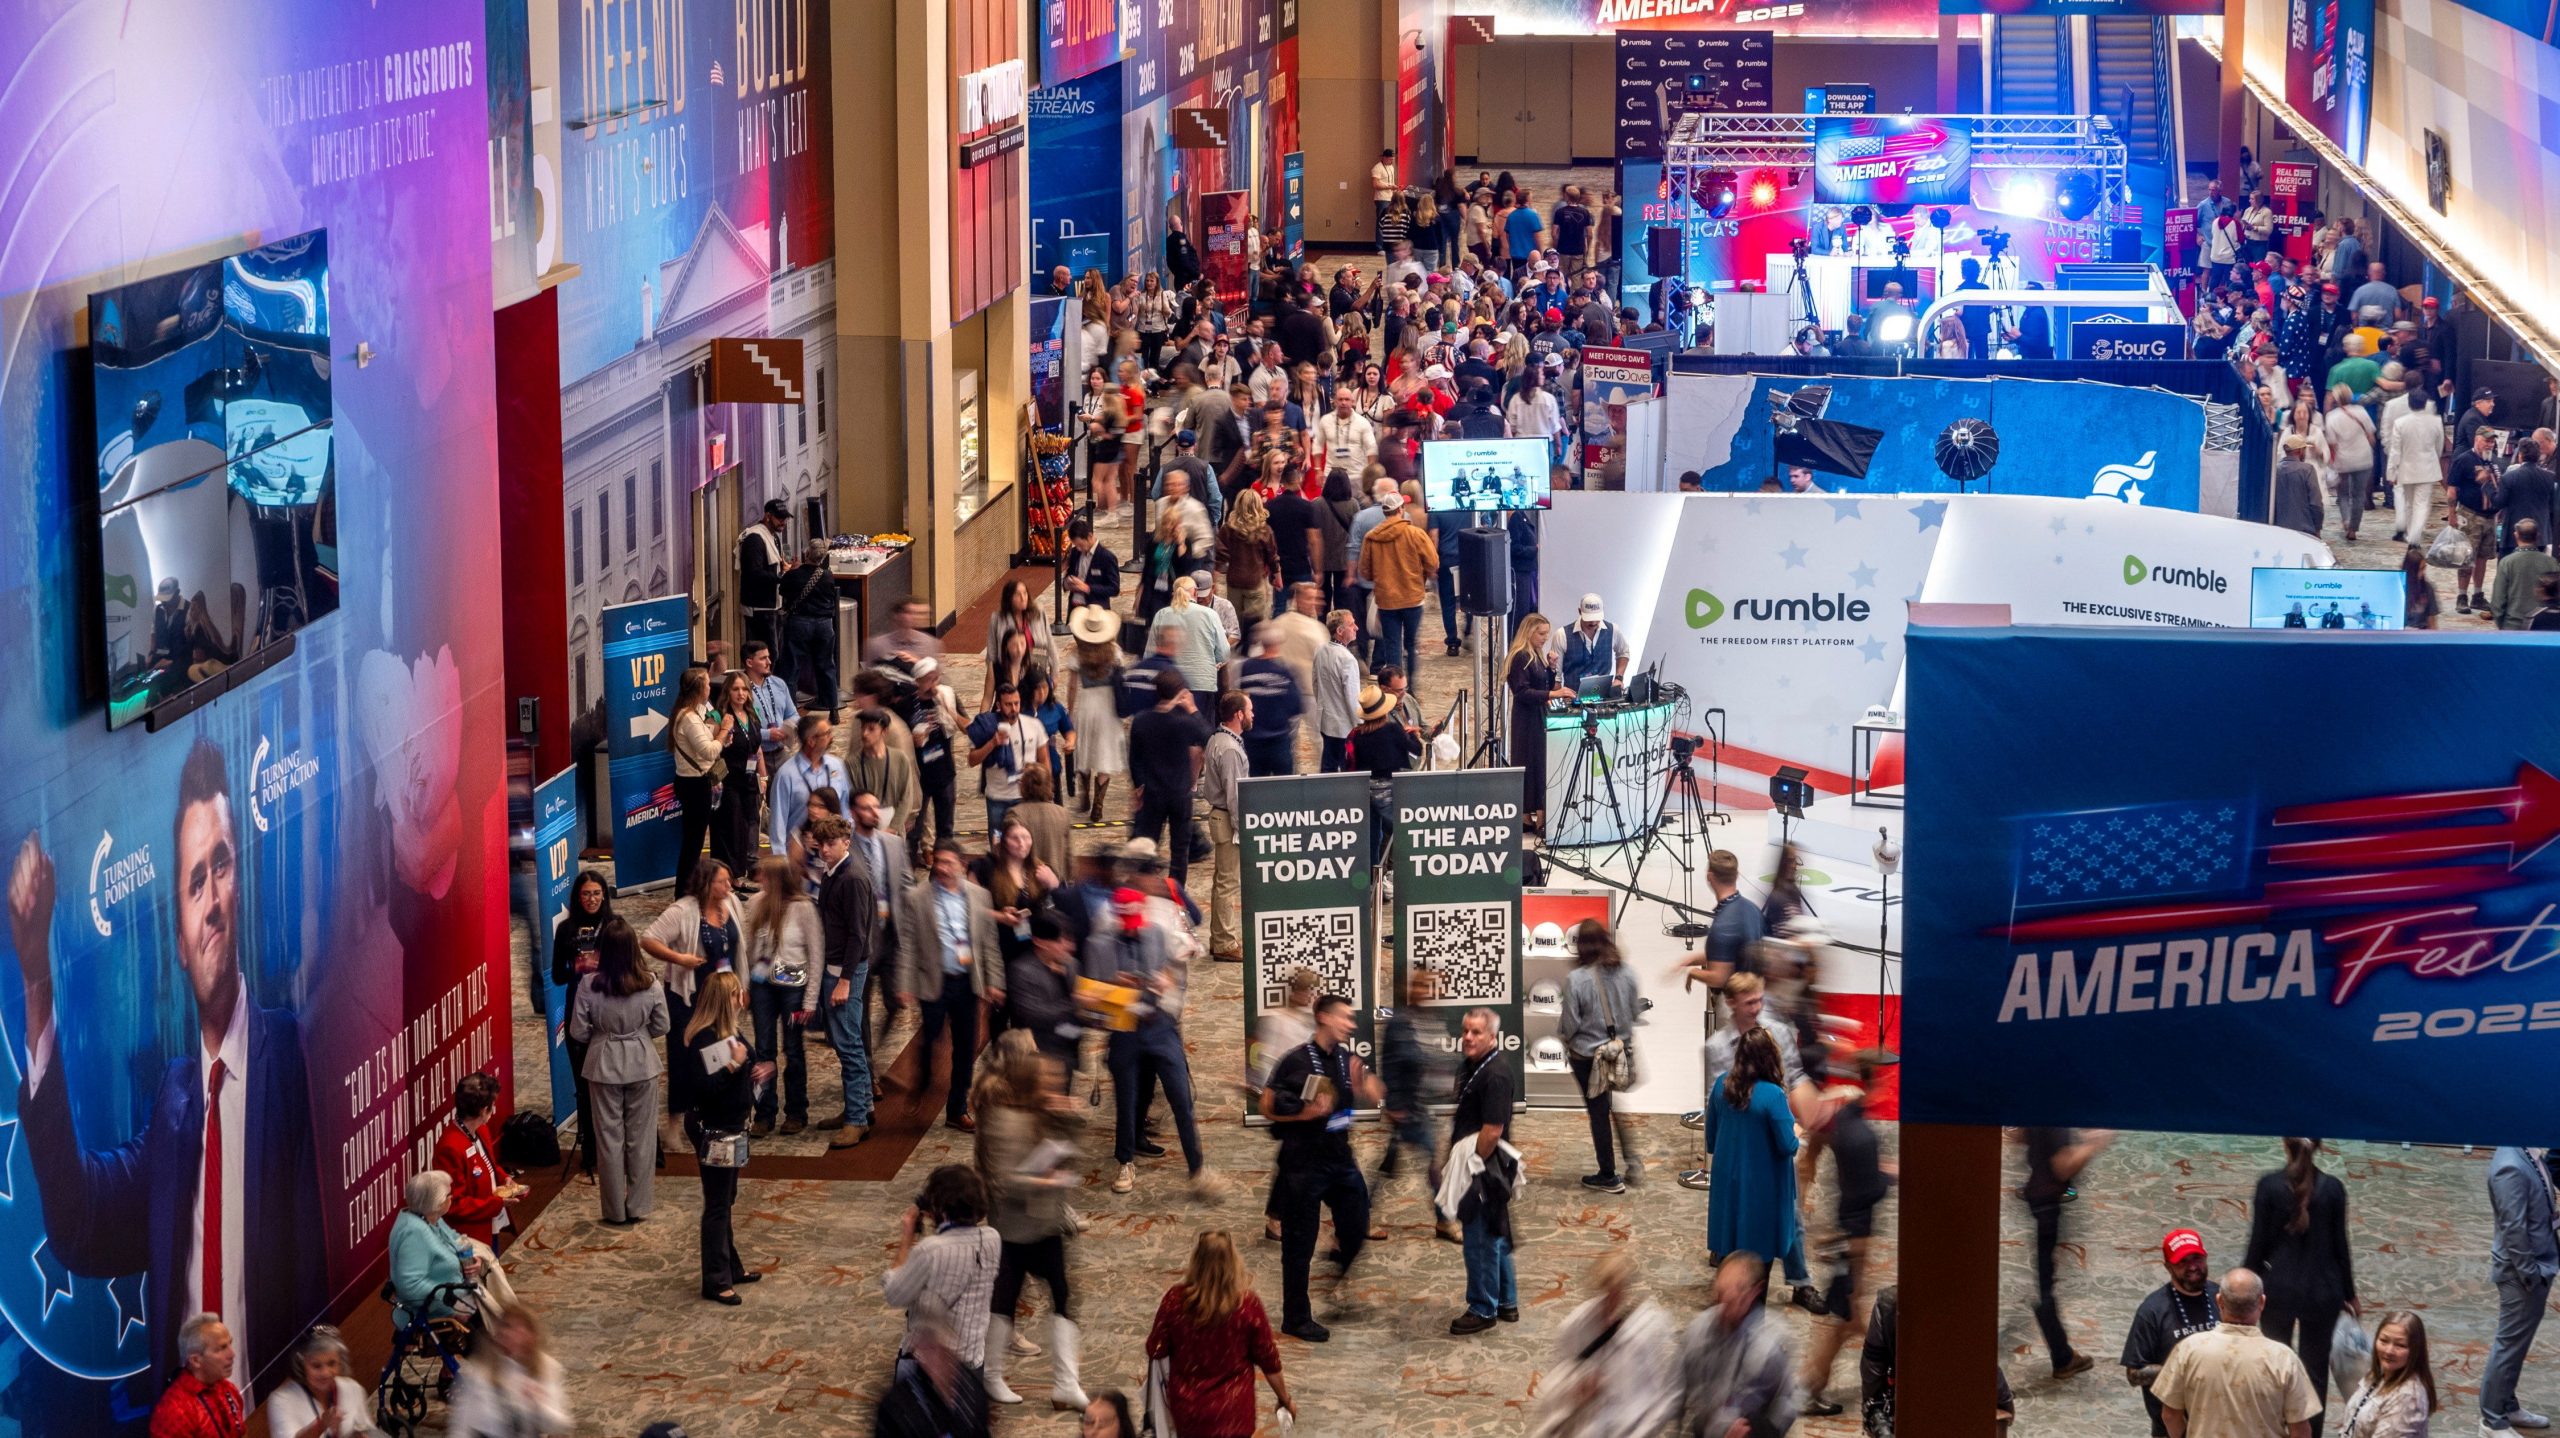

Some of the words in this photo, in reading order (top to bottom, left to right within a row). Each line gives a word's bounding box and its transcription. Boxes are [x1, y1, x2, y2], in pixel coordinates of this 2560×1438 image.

[1735, 4, 1804, 24] 2025
[736, 0, 808, 100] BUILD
[1629, 38, 1651, 46] rumble
[1706, 39, 1729, 47] rumble
[1179, 43, 1195, 77] 2016
[299, 62, 352, 122] MOVEMENT
[357, 59, 369, 110] IS
[374, 57, 380, 106] A
[384, 40, 473, 104] GRASSROOTS
[1139, 59, 1156, 96] 2003
[1744, 99, 1767, 107] rumble
[738, 99, 777, 175] WHAT'S
[783, 89, 808, 159] NEXT
[311, 126, 365, 187] MOVEMENT
[370, 121, 381, 173] AT
[384, 117, 402, 169] ITS
[972, 149, 984, 162] QUICK
[985, 143, 997, 157] BITES
[1000, 137, 1010, 151] COLD
[584, 137, 640, 233] WHAT'S
[650, 123, 687, 209] OURS
[1835, 161, 1897, 183] AMERICA
[1906, 174, 1946, 184] 2025
[2274, 176, 2312, 185] AMERICA'S
[2276, 168, 2293, 176] REAL
[2274, 184, 2297, 193] VOICE
[1535, 340, 1554, 348] JESUS
[1588, 352, 1604, 360] MEET
[1606, 354, 1627, 362] FOURG
[1628, 356, 1645, 364] DAVE
[2152, 566, 2228, 594] rumble
[1733, 592, 1871, 622] rumble
[2062, 601, 2087, 613] THE
[2089, 603, 2153, 621] EXCLUSIVE
[1700, 637, 1719, 645] THE
[1722, 637, 1768, 645] FREEDOM
[1771, 638, 1799, 646] FIRST
[1802, 638, 1855, 646] PLATFORM
[630, 653, 665, 688] VIP
[632, 687, 667, 701] LOUNGE
[261, 750, 300, 786] TURNING
[261, 778, 288, 806] POINT
[289, 757, 320, 791] ACTION
[626, 807, 659, 829] AMERICA
[1245, 807, 1364, 830] DOWNLOAD
[1400, 803, 1518, 824] DOWNLOAD
[1253, 833, 1302, 854] THE
[1308, 831, 1358, 851] APP
[1408, 826, 1456, 848] THE
[1461, 825, 1511, 846] APP
[103, 844, 150, 884] TURNING
[549, 837, 568, 881] VIP
[1256, 856, 1356, 883] TODAY
[1409, 851, 1509, 877] TODAY
[105, 872, 135, 909] POINT
[136, 862, 156, 892] USA
[551, 877, 570, 897] LOUNGE
[1535, 937, 1557, 946] RUMBLE
[1997, 928, 2317, 1024] AMERICA
[2324, 903, 2560, 1006] Fest
[1533, 994, 1554, 1004] RUMBLE
[2373, 1001, 2560, 1042] 2025
[345, 1060, 371, 1119] "GOD
[376, 1046, 387, 1100] IS
[391, 1026, 410, 1085] NOT
[413, 1003, 437, 1066] DONE
[441, 981, 463, 1042] WITH
[466, 961, 488, 1019] THIS
[1539, 1051, 1562, 1060] RUMBLE
[342, 1108, 389, 1191] COUNTRY,
[392, 1089, 410, 1148] AND
[413, 1074, 426, 1127] WE
[430, 1056, 446, 1115] ARE
[449, 1038, 467, 1095] NOT
[470, 1016, 493, 1074] DONE
[349, 1162, 398, 1250] FIGHTING
